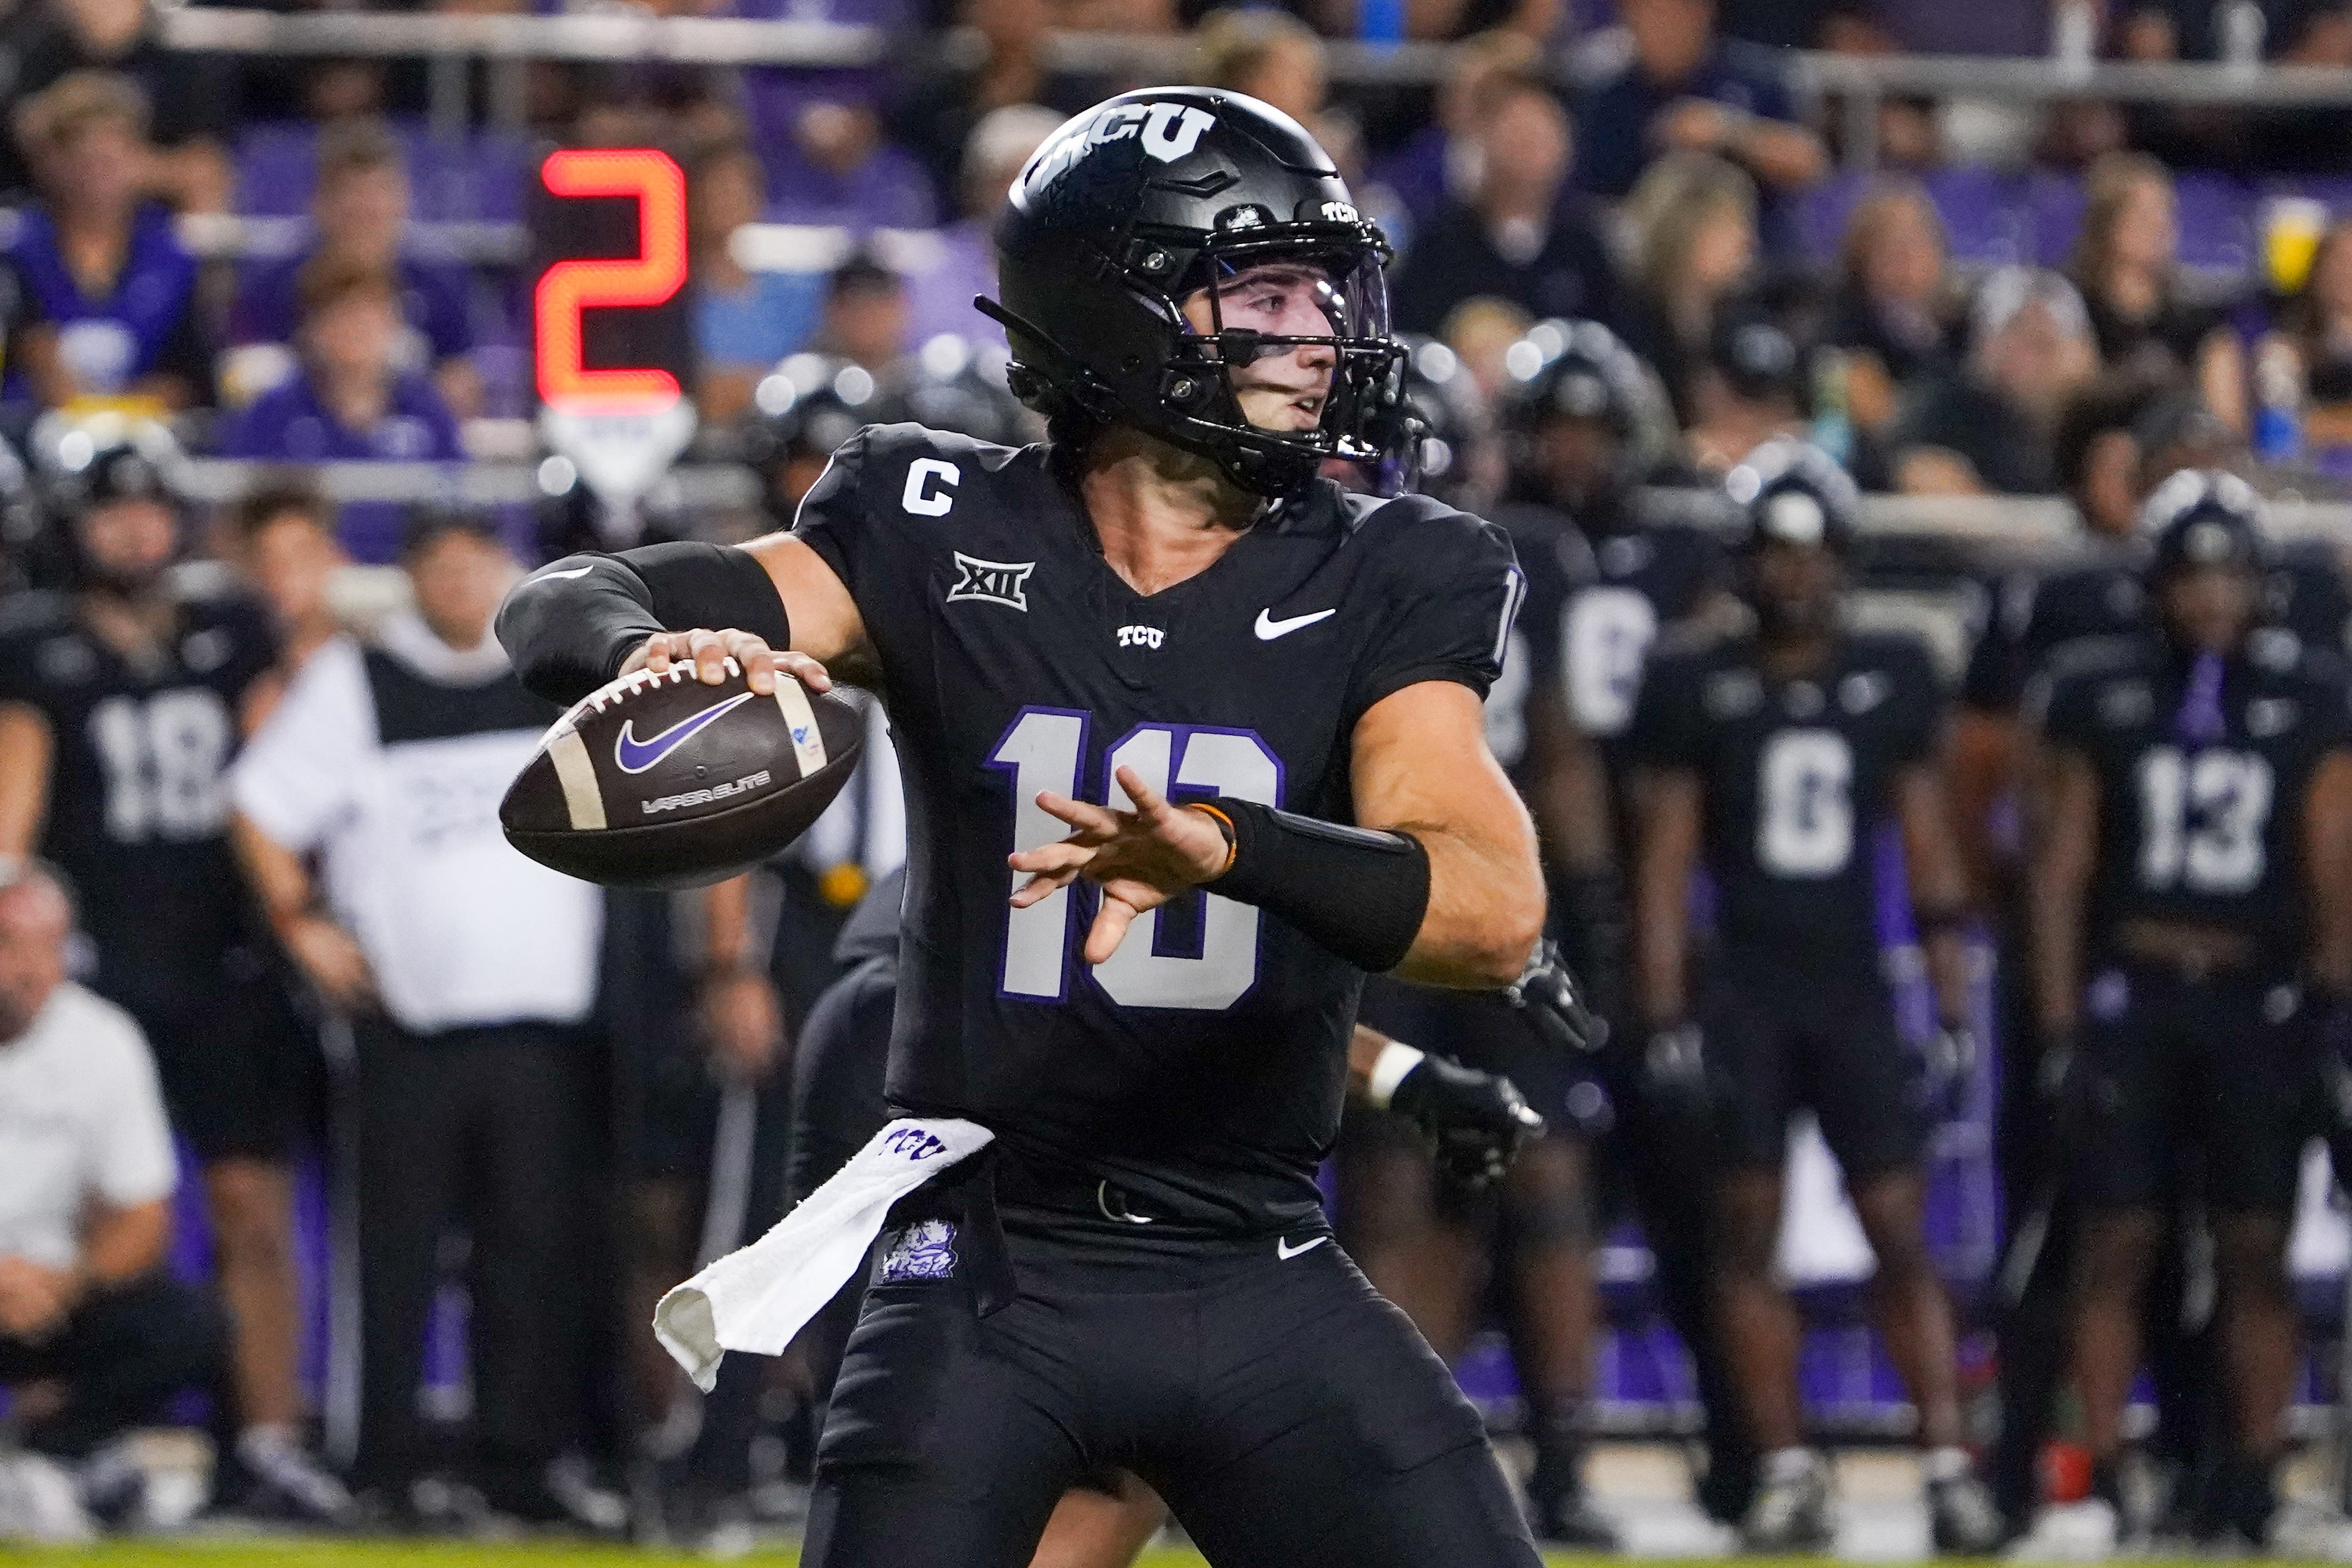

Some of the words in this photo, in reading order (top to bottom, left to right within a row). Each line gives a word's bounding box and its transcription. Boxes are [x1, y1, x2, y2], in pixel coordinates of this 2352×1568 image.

[536, 149, 687, 416] 2
[902, 457, 960, 516] C
[952, 557, 1030, 607] XII
[1117, 625, 1164, 649] TCU
[713, 770, 771, 799] ELITE
[2137, 742, 2275, 893] 13
